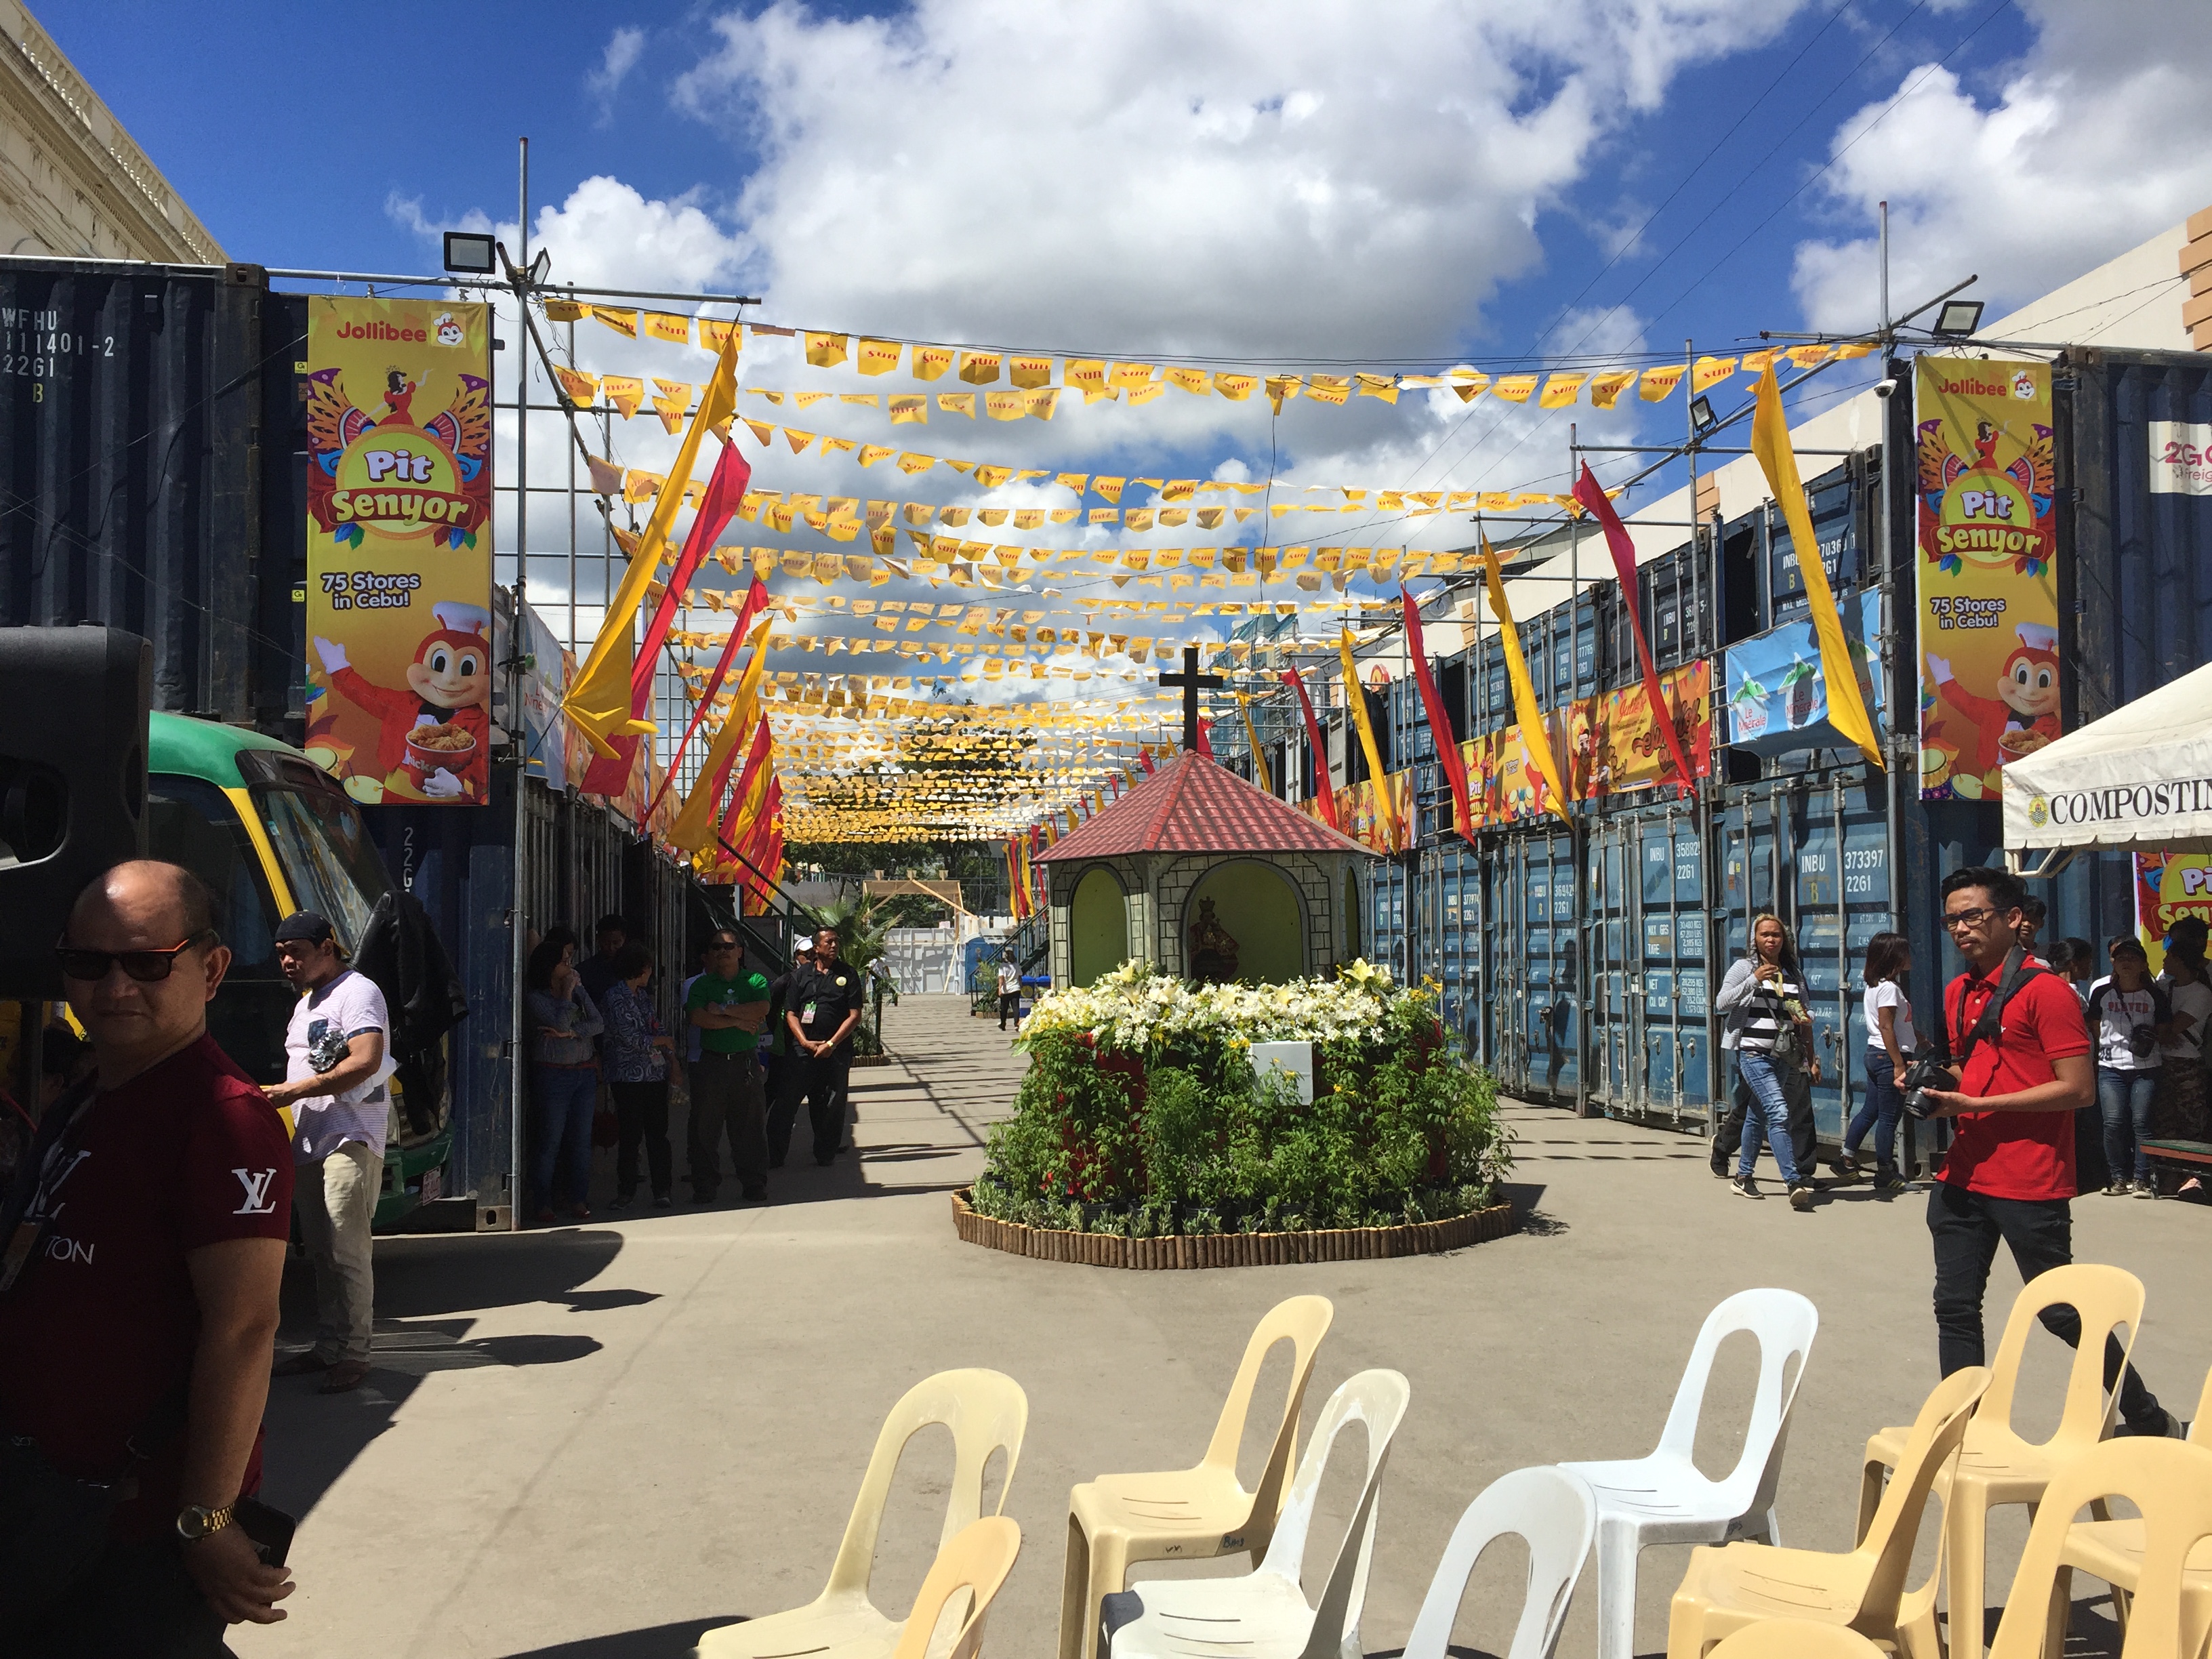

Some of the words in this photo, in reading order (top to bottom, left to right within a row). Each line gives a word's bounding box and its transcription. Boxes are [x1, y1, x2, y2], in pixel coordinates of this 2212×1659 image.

[2, 307, 57, 331] WFHU
[336, 321, 428, 343] Jollibee
[657, 322, 686, 336] sun
[6, 331, 115, 357] 111401-2
[815, 341, 844, 352] sun
[867, 350, 897, 361] sun
[922, 354, 949, 364] sun
[970, 358, 998, 366] sun
[3, 354, 54, 377] 22G1
[1020, 363, 1049, 371] sun
[1703, 366, 1732, 379] sun
[1075, 370, 1102, 380] sun
[1650, 377, 1679, 386] sun
[33, 383, 44, 403] B
[1552, 384, 1578, 395] sun
[1938, 377, 2007, 397] Jollibee
[364, 449, 434, 483] Pit
[1099, 484, 1122, 493] sun
[1172, 485, 1195, 494] sun
[334, 489, 471, 527] Senyor
[1960, 491, 2013, 519] Pit
[874, 533, 894, 544] sun
[1936, 526, 2043, 556] Senyor
[937, 544, 957, 554] sun
[321, 573, 347, 593] 75
[350, 572, 421, 593] Stores
[1789, 573, 1795, 590] B
[333, 592, 353, 611] in
[355, 590, 411, 610] Cebu!
[1931, 598, 1952, 614] 75
[1954, 597, 2006, 615] Stores
[1939, 614, 1954, 630] in
[1957, 614, 1999, 628] Cebu!
[1560, 667, 1567, 680] FG
[1795, 690, 1805, 703] Le
[1744, 707, 1753, 720] Le
[1469, 779, 1482, 798] Pit
[403, 826, 414, 893] 22G
[1650, 847, 1665, 861] INBU
[1801, 854, 1826, 873] INBU
[1845, 849, 1883, 869] 373397
[1677, 864, 1694, 880] 22G1
[1810, 882, 1818, 903] B
[1846, 875, 1871, 893] 22G1
[1554, 901, 1569, 914] 22G1
[2158, 904, 2212, 931] Sen
[1647, 943, 1660, 955] TARE
[1649, 979, 1658, 989] NET
[1658, 996, 1668, 1008] CAP
